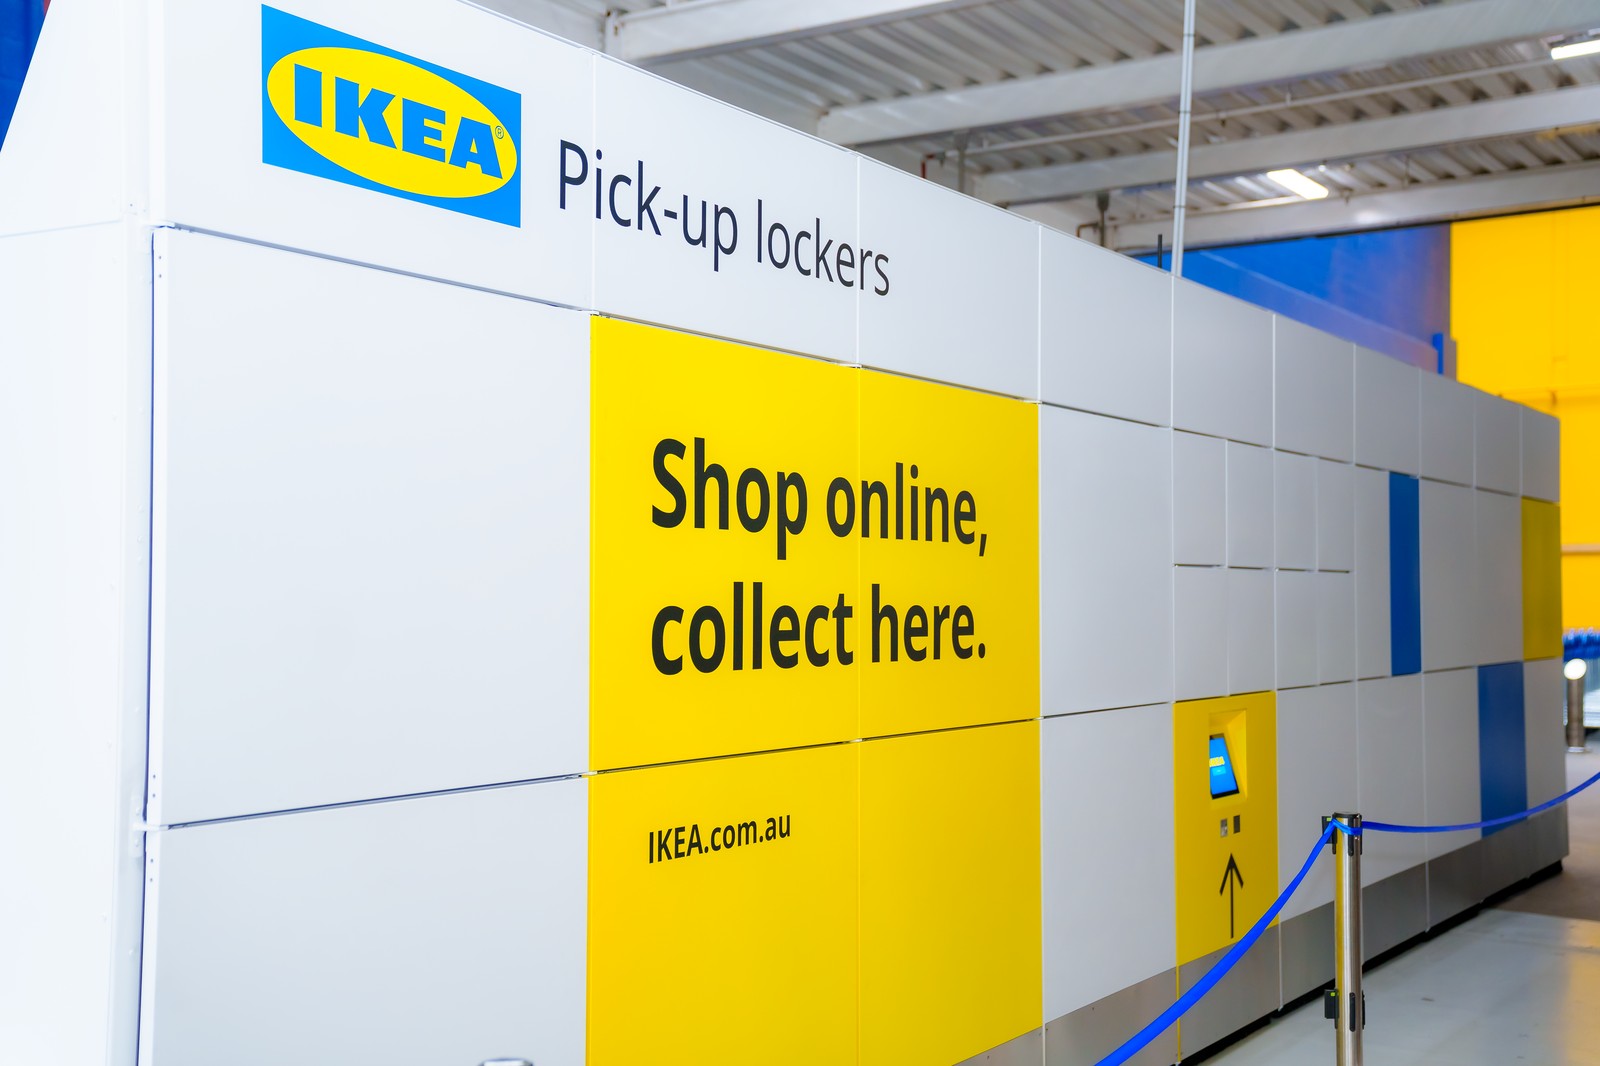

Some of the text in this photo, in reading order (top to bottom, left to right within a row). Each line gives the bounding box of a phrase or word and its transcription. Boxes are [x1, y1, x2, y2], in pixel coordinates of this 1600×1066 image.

[294, 63, 504, 180] IKEA
[559, 139, 891, 297] Pick-up lockers
[650, 436, 989, 561] Shop online,
[650, 581, 987, 676] collect here.
[648, 814, 791, 864] IKEA.com.au
